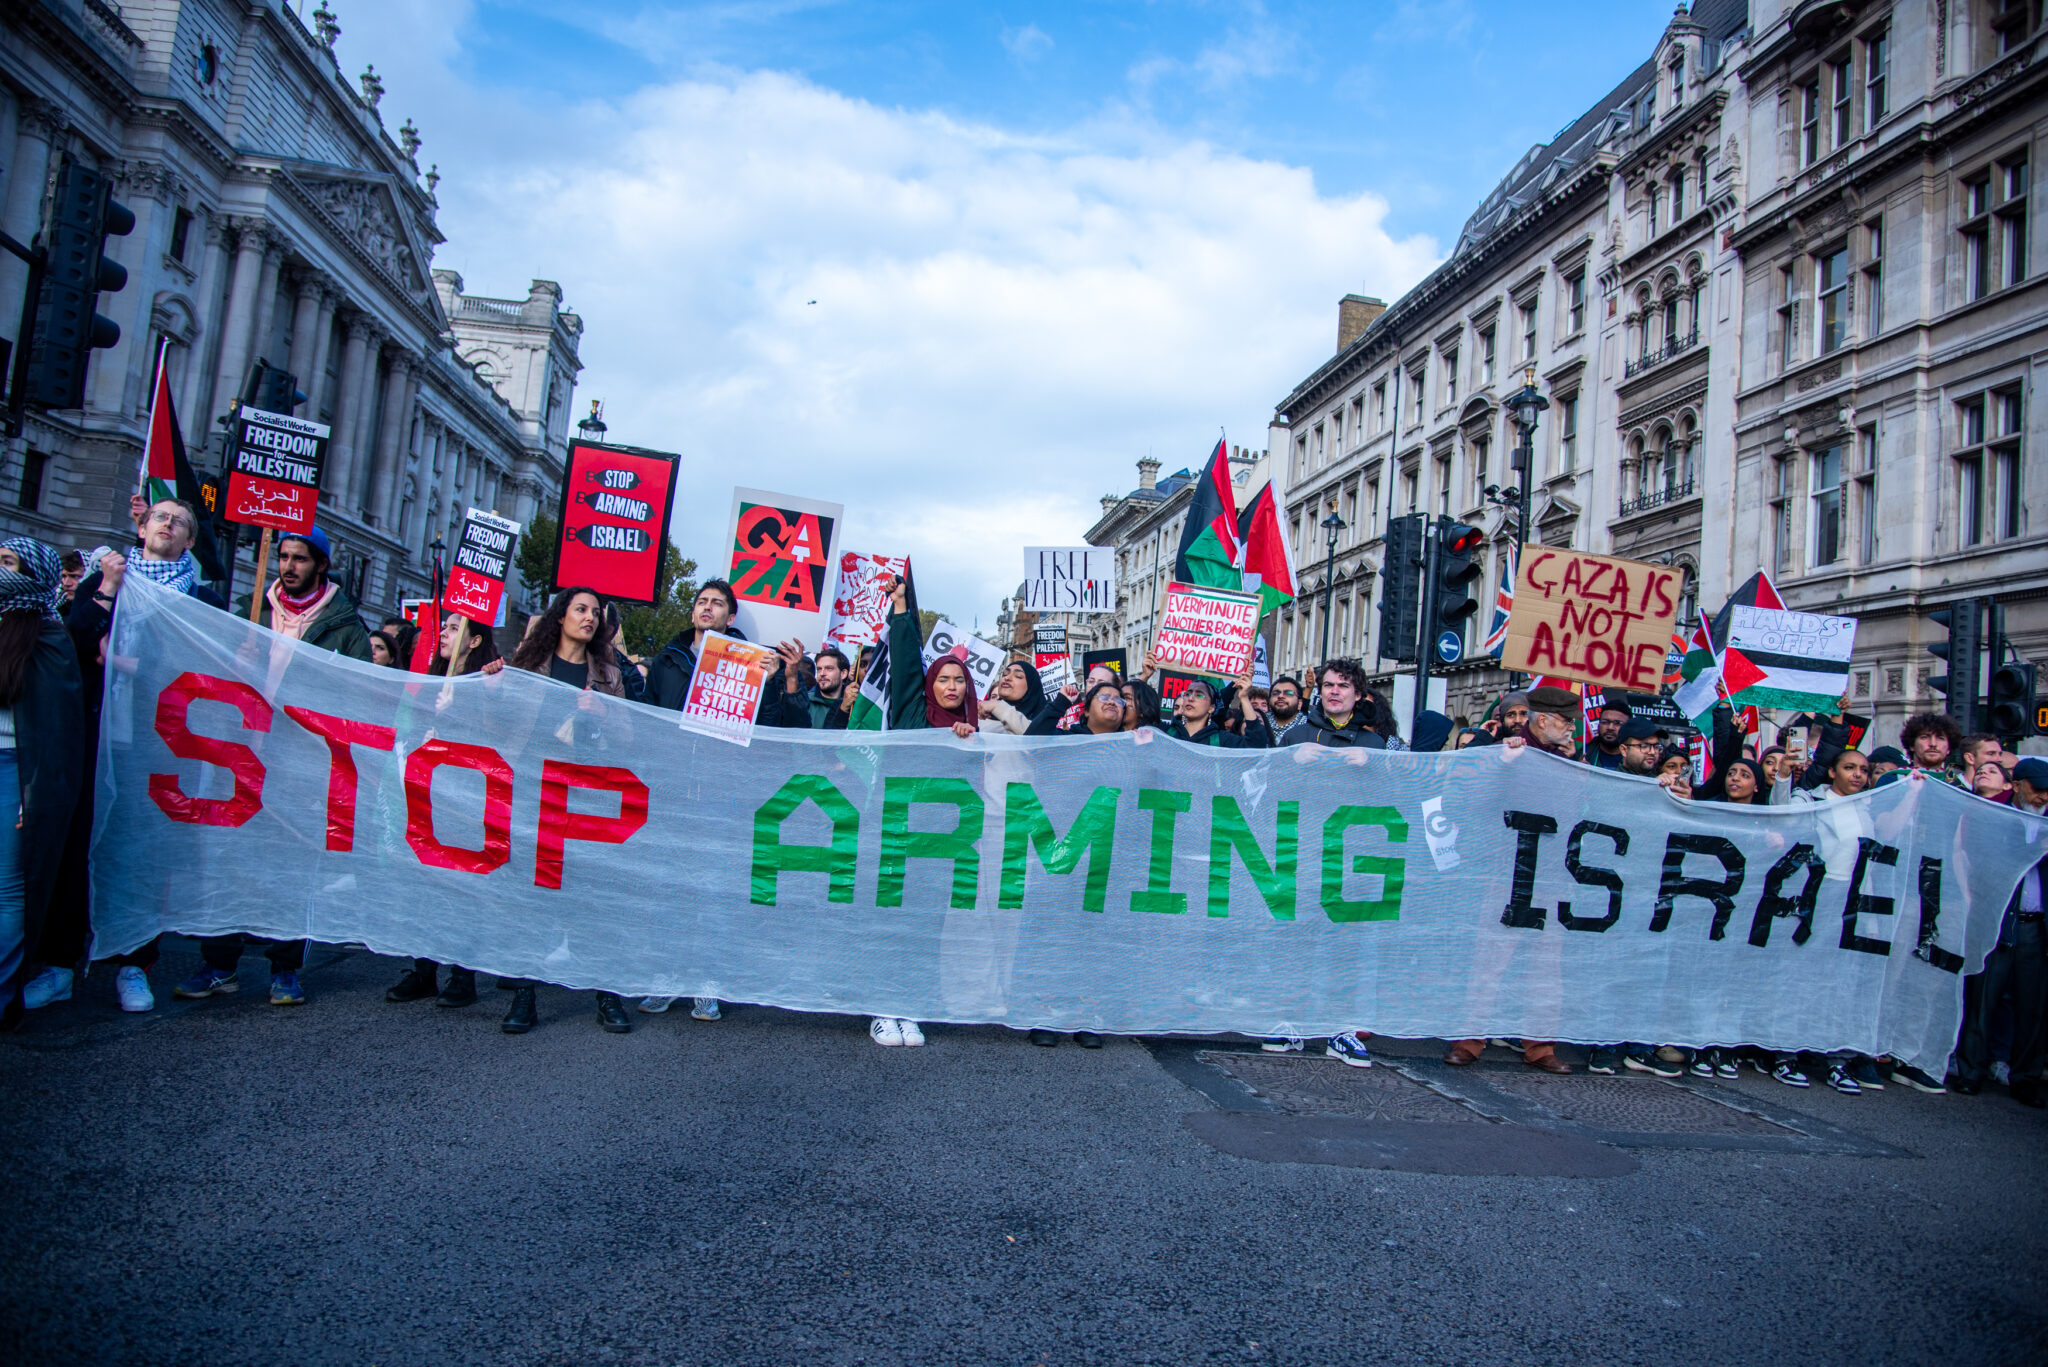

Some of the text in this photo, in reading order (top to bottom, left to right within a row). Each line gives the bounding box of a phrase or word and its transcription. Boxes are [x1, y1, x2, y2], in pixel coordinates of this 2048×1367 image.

[287, 420, 317, 434] Worker
[245, 424, 318, 458] FREEDOM
[273, 449, 286, 460] for
[237, 451, 318, 485] PALESTINE
[604, 470, 635, 489] STOP
[247, 480, 299, 502] الحرية
[237, 500, 304, 521] لفلسطين
[594, 492, 648, 521] ARMING
[465, 523, 509, 552] FREEDOM
[591, 525, 641, 552] ISRAEL
[457, 547, 506, 577] PALESTINE
[1040, 551, 1096, 580] FREE
[459, 572, 489, 593] الحرية
[1024, 579, 1114, 610] PALESTINE
[1527, 553, 1673, 618] GAZA IS
[450, 591, 490, 611] لفلسطين
[1164, 614, 1256, 640] ANOTHER BOMB!
[1559, 599, 1644, 645] NOT
[1733, 606, 1839, 637] HANDS
[1036, 643, 1066, 653] PALESTIN
[1157, 630, 1252, 655] HOW MUCH BLOOD
[1527, 621, 1665, 690] ALONE
[1760, 631, 1829, 656] OFF!
[716, 658, 748, 682] END
[1154, 644, 1178, 663] DO
[1179, 647, 1207, 669] YOU
[696, 671, 759, 702] ISRAELI
[700, 689, 748, 716] STATE
[1585, 694, 1607, 709] AZA
[1630, 704, 1677, 718] minster
[685, 702, 752, 734] TERROR
[148, 671, 650, 890] STOP
[750, 773, 1410, 923] ARMING
[1500, 809, 1965, 975] ISRAEL
